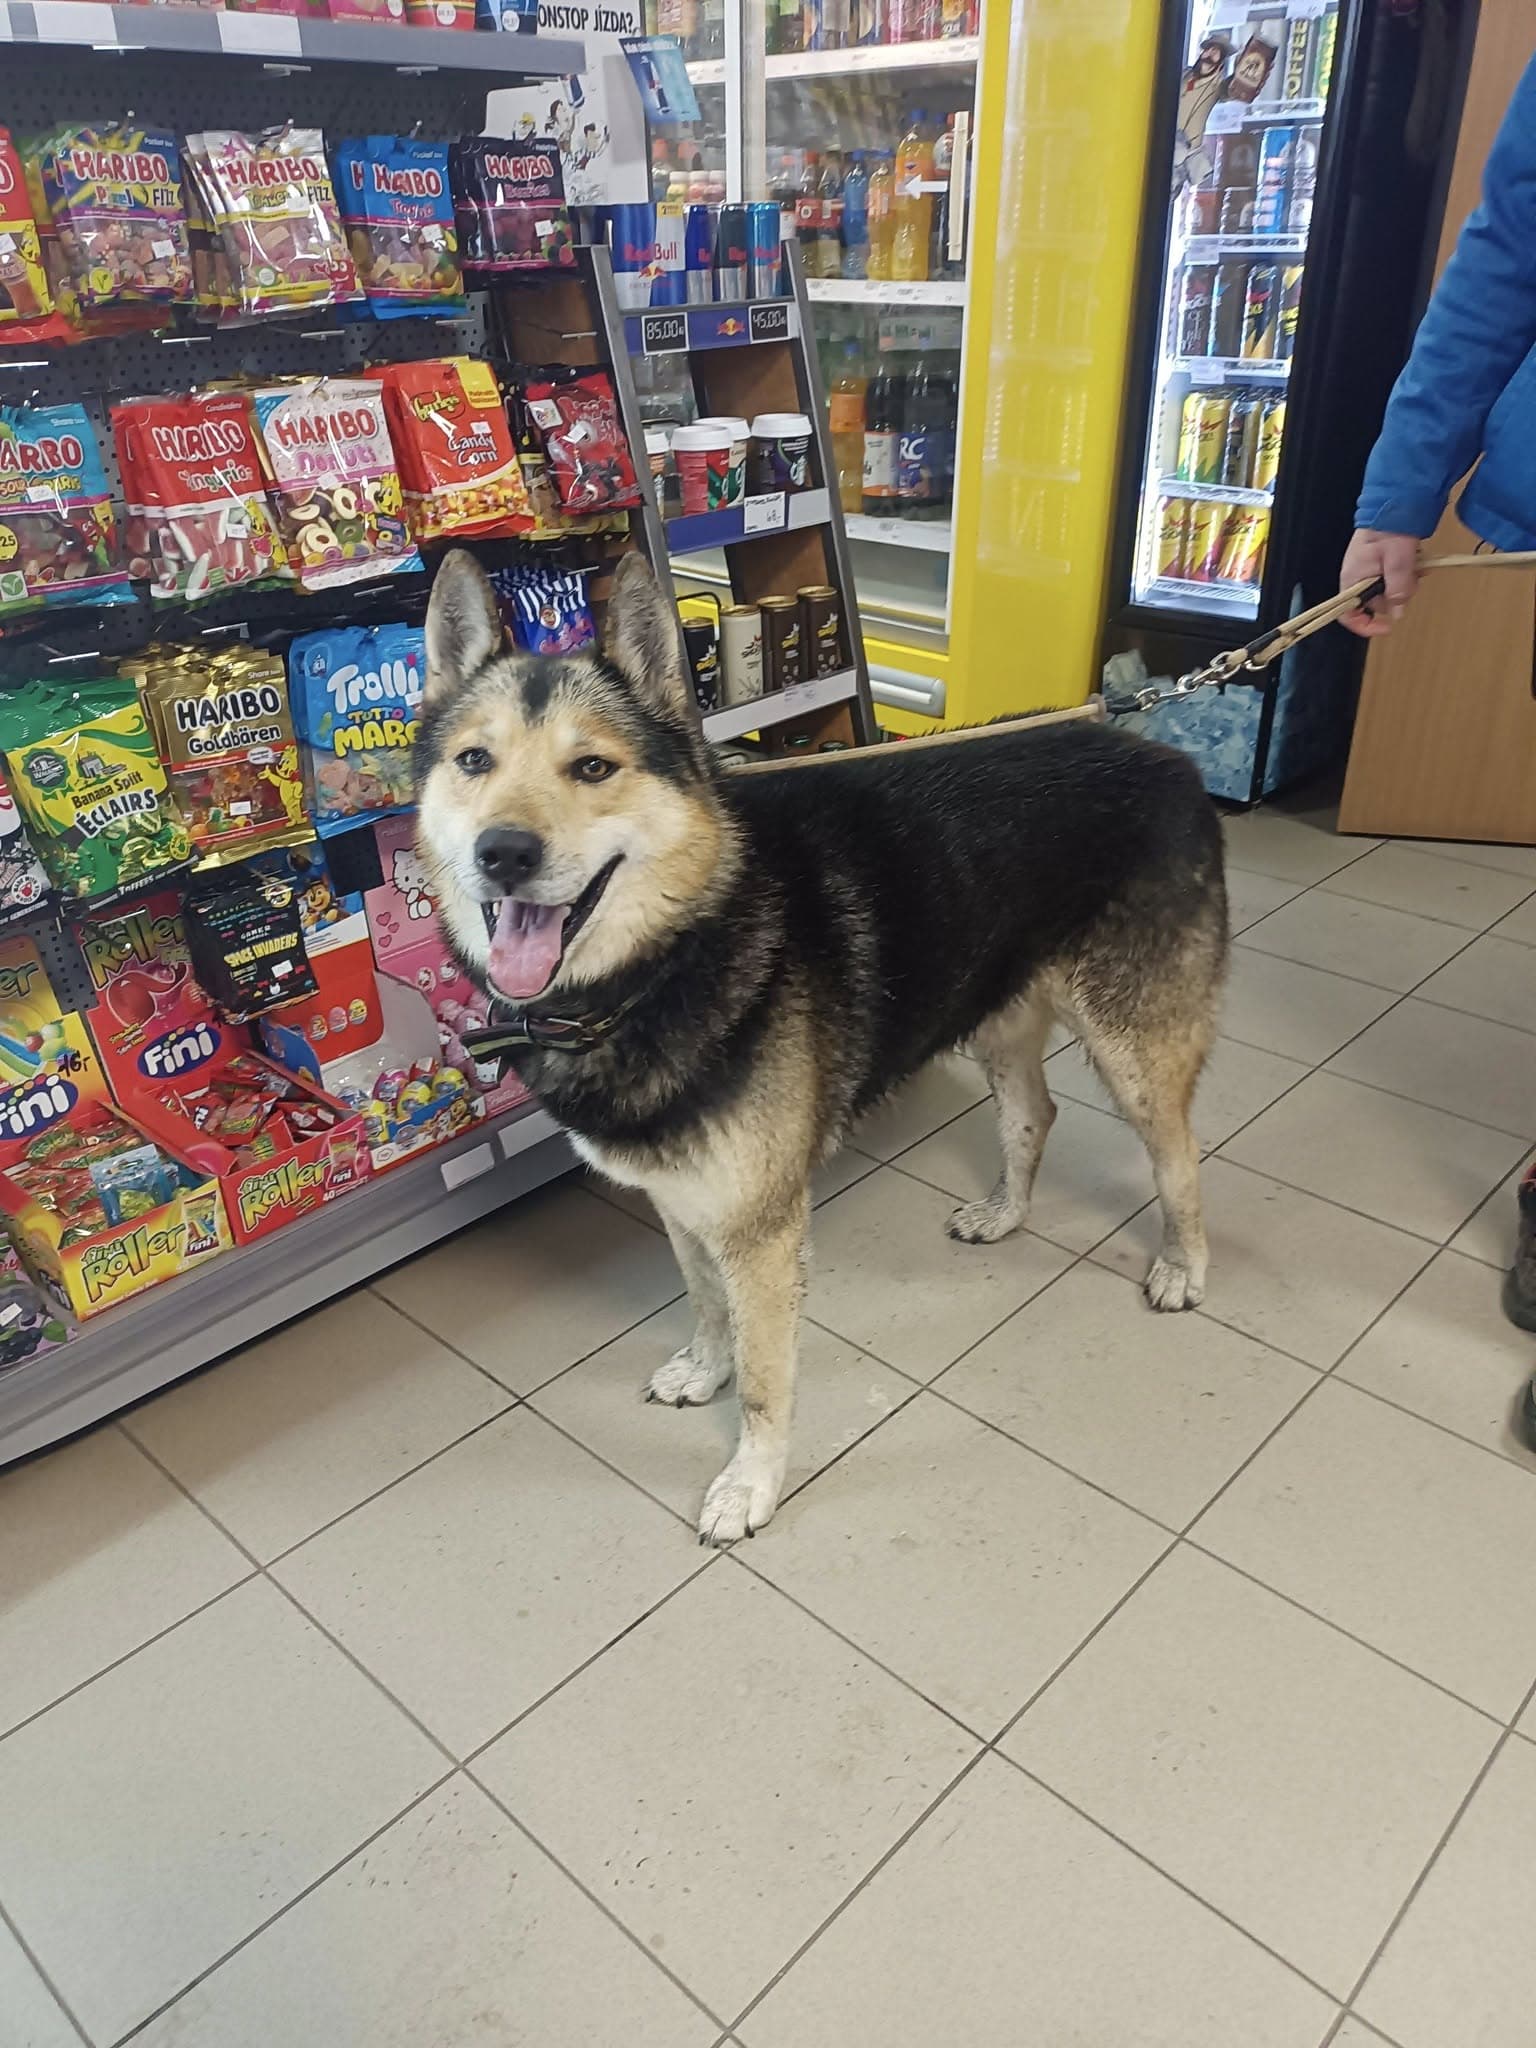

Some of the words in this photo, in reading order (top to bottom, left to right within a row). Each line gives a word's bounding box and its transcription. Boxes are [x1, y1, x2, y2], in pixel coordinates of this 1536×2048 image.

[538, 4, 589, 30] ONSTOP
[593, 6, 634, 34] JÍZDA?
[1285, 19, 1309, 100] OFFEE
[70, 149, 169, 184] HARIBO
[226, 157, 321, 188] HARIBO
[485, 154, 554, 181] HARIBO
[655, 242, 677, 261] Bull
[274, 408, 379, 449] HARIBO
[447, 432, 498, 453] Candy
[0, 435, 83, 473] ARBO
[295, 443, 378, 475] Donuts
[457, 450, 498, 467] Corn
[326, 652, 419, 714] Trolli
[176, 685, 282, 732] HARIBO
[347, 707, 406, 724] TUTTO
[188, 725, 281, 755] Goldbären
[72, 785, 115, 809] Banana
[113, 771, 144, 791] Split
[75, 788, 158, 838] ÉCLAIRS
[223, 947, 255, 968] SPACE
[252, 932, 298, 959] INVADERS
[144, 1022, 214, 1077] Fini
[239, 1156, 331, 1232] Roller
[81, 1224, 187, 1303] Roller
